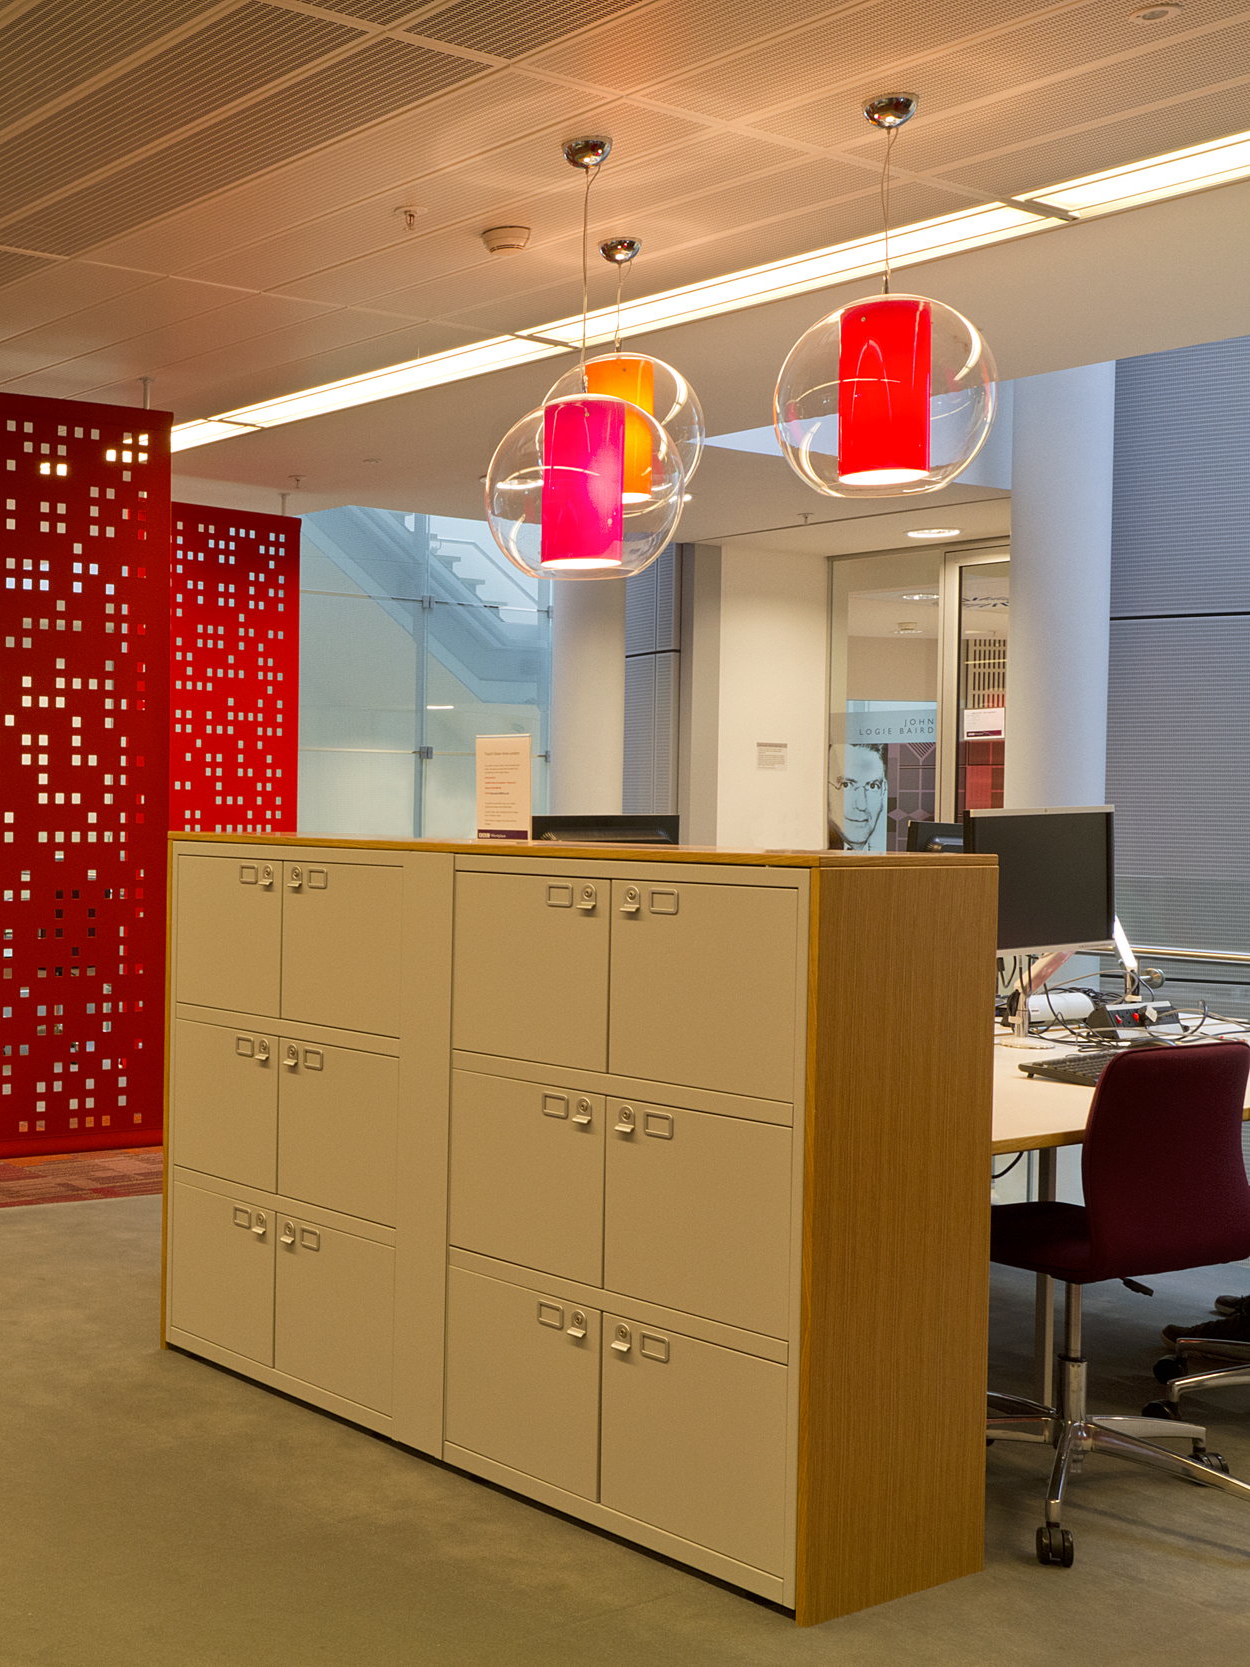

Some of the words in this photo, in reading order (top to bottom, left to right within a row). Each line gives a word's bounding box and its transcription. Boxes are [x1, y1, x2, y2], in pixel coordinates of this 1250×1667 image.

[904, 718, 934, 727] JOHN
[859, 727, 892, 736] LOGIE
[899, 726, 934, 735] BAIRD
